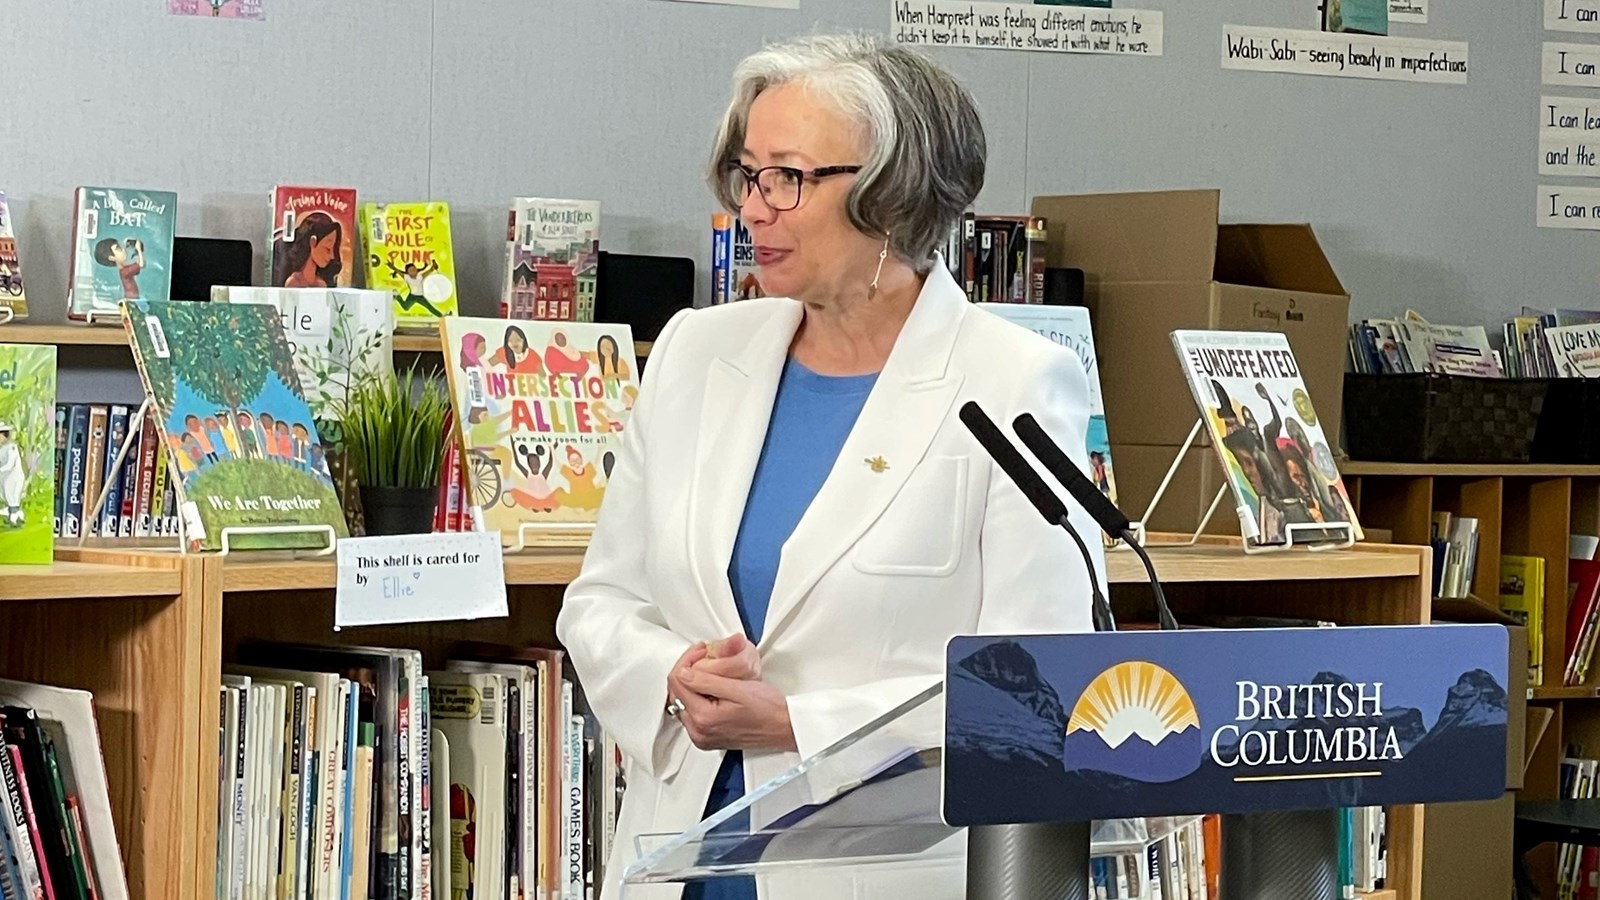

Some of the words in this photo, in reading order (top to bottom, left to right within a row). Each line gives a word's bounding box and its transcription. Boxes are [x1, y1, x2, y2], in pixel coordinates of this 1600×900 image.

[895, 1, 923, 23] When
[927, 4, 974, 29] Harpreet
[979, 15, 999, 27] was
[1003, 7, 1036, 36] feeling
[1042, 10, 1085, 31] different
[1132, 15, 1141, 34] he
[1557, 0, 1568, 19] I
[1576, 8, 1598, 21] can
[896, 26, 927, 43] didn't
[932, 29, 950, 44] keep
[962, 28, 970, 43] to
[1011, 30, 1023, 47] he
[1027, 34, 1058, 49] showed
[1070, 34, 1090, 50] with
[1117, 36, 1125, 52] he
[1309, 47, 1344, 71] seeing
[1349, 43, 1381, 72] beauty
[1384, 51, 1395, 68] in
[1400, 50, 1467, 74] imperfections
[1558, 52, 1568, 74] I
[1575, 62, 1595, 75] can
[1547, 105, 1557, 127] I
[1559, 114, 1578, 128] can
[1546, 146, 1569, 166] and
[1575, 144, 1596, 167] the
[109, 210, 147, 228] BAT
[129, 198, 165, 215] Called
[1548, 194, 1559, 217] I
[1564, 204, 1586, 219] can
[386, 216, 434, 231] FIRST
[384, 232, 425, 248] RULE
[387, 250, 435, 266] PUNK
[1560, 331, 1587, 352] LOVE
[1196, 348, 1298, 378] UNDEFEATED
[485, 372, 618, 400] INTERSECTION
[511, 400, 611, 433] ALLIES
[580, 435, 593, 443] for
[597, 436, 607, 444] all
[144, 450, 154, 468] THE
[70, 448, 82, 504] poached
[207, 495, 231, 511] We
[235, 495, 259, 511] Are
[259, 494, 321, 512] Together
[356, 556, 379, 569] This
[383, 554, 409, 567] shelf
[413, 554, 423, 566] is
[426, 552, 459, 565] cared
[463, 552, 480, 564] for
[356, 572, 370, 587] by
[383, 576, 415, 599] Ellie
[1235, 680, 1384, 721] BRITISH
[400, 727, 409, 759] HOBBIT
[1210, 724, 1404, 767] COLUMBIA
[327, 750, 337, 792] GREAT
[526, 753, 534, 792] DANCER
[400, 760, 409, 815] COMPANION
[10, 790, 25, 824] BOOKS
[235, 783, 243, 826] MONET
[570, 787, 581, 838] GAMES
[289, 806, 298, 841] GOGH
[323, 797, 335, 873] COMPOSERS
[421, 858, 430, 879] The
[570, 842, 581, 884] BOOK
